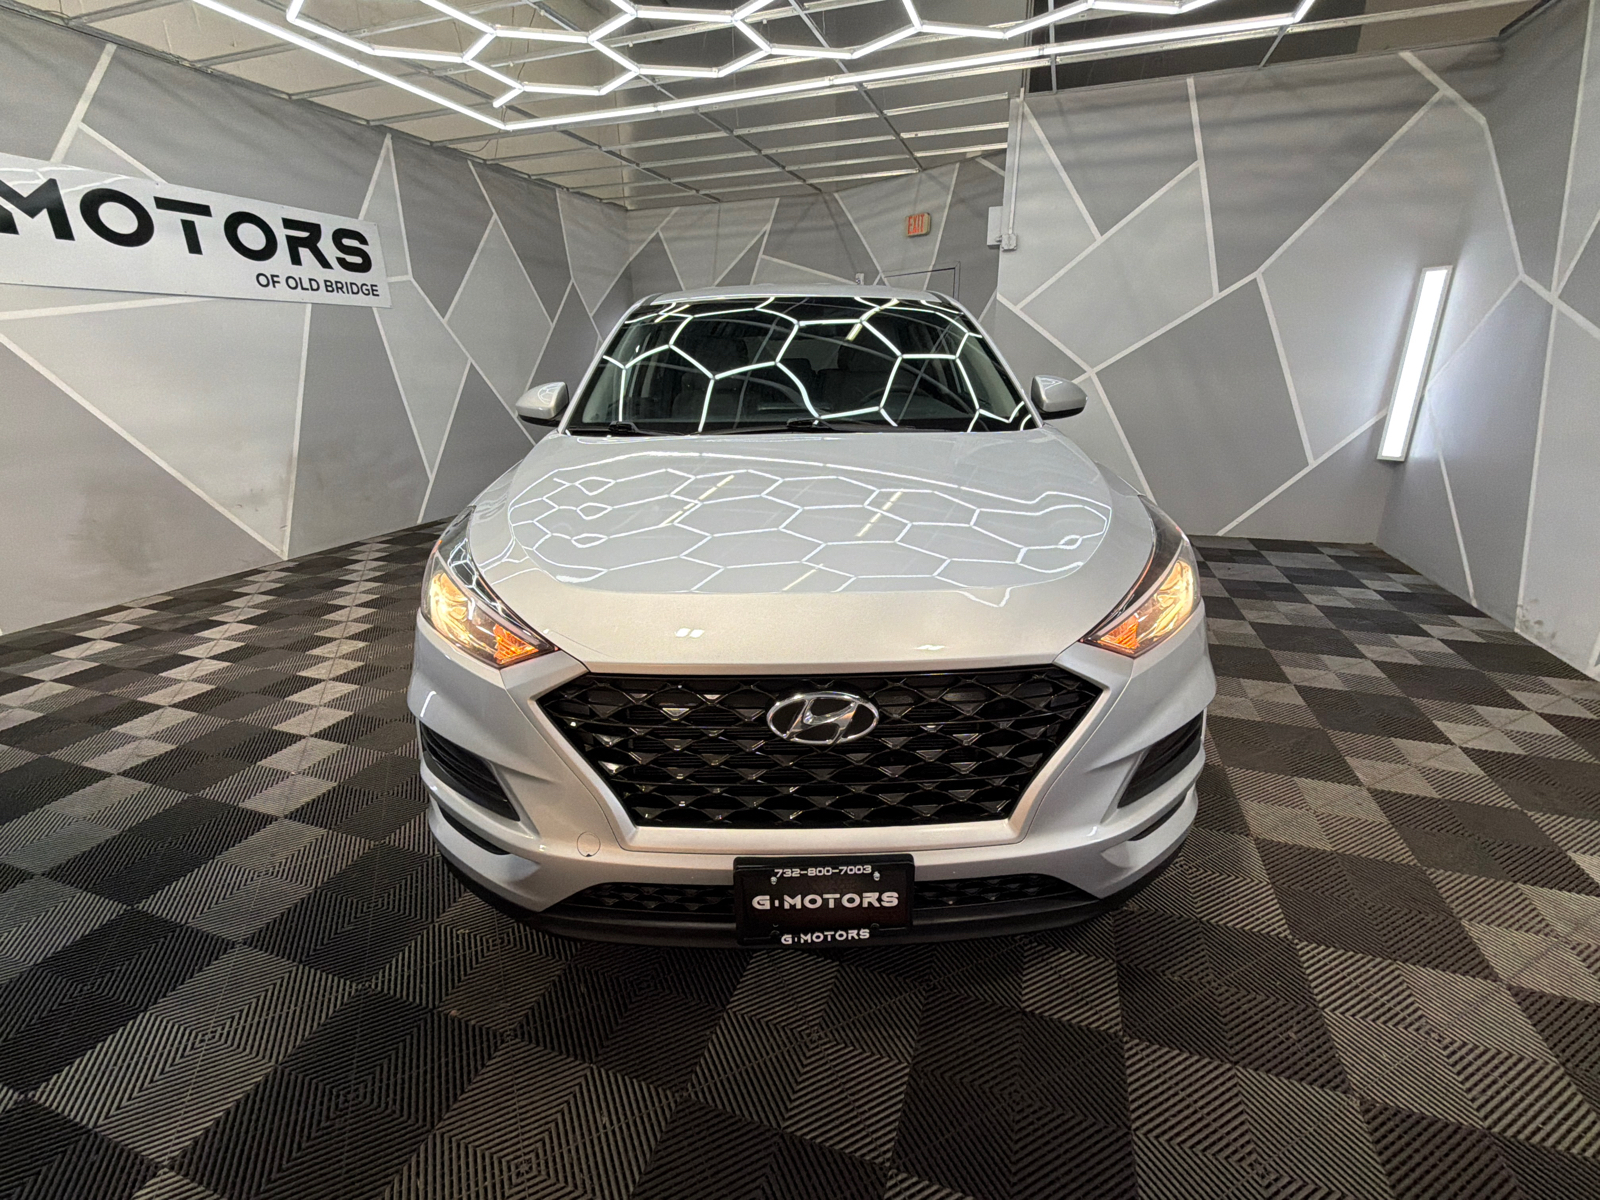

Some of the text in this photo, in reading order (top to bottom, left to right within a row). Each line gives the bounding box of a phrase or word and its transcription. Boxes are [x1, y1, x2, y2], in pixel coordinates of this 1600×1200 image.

[0, 177, 373, 274] MOTORS
[907, 213, 925, 235] EXIT
[255, 272, 380, 297] OF OLD BRIDGE
[774, 865, 872, 878] 732-800-7003
